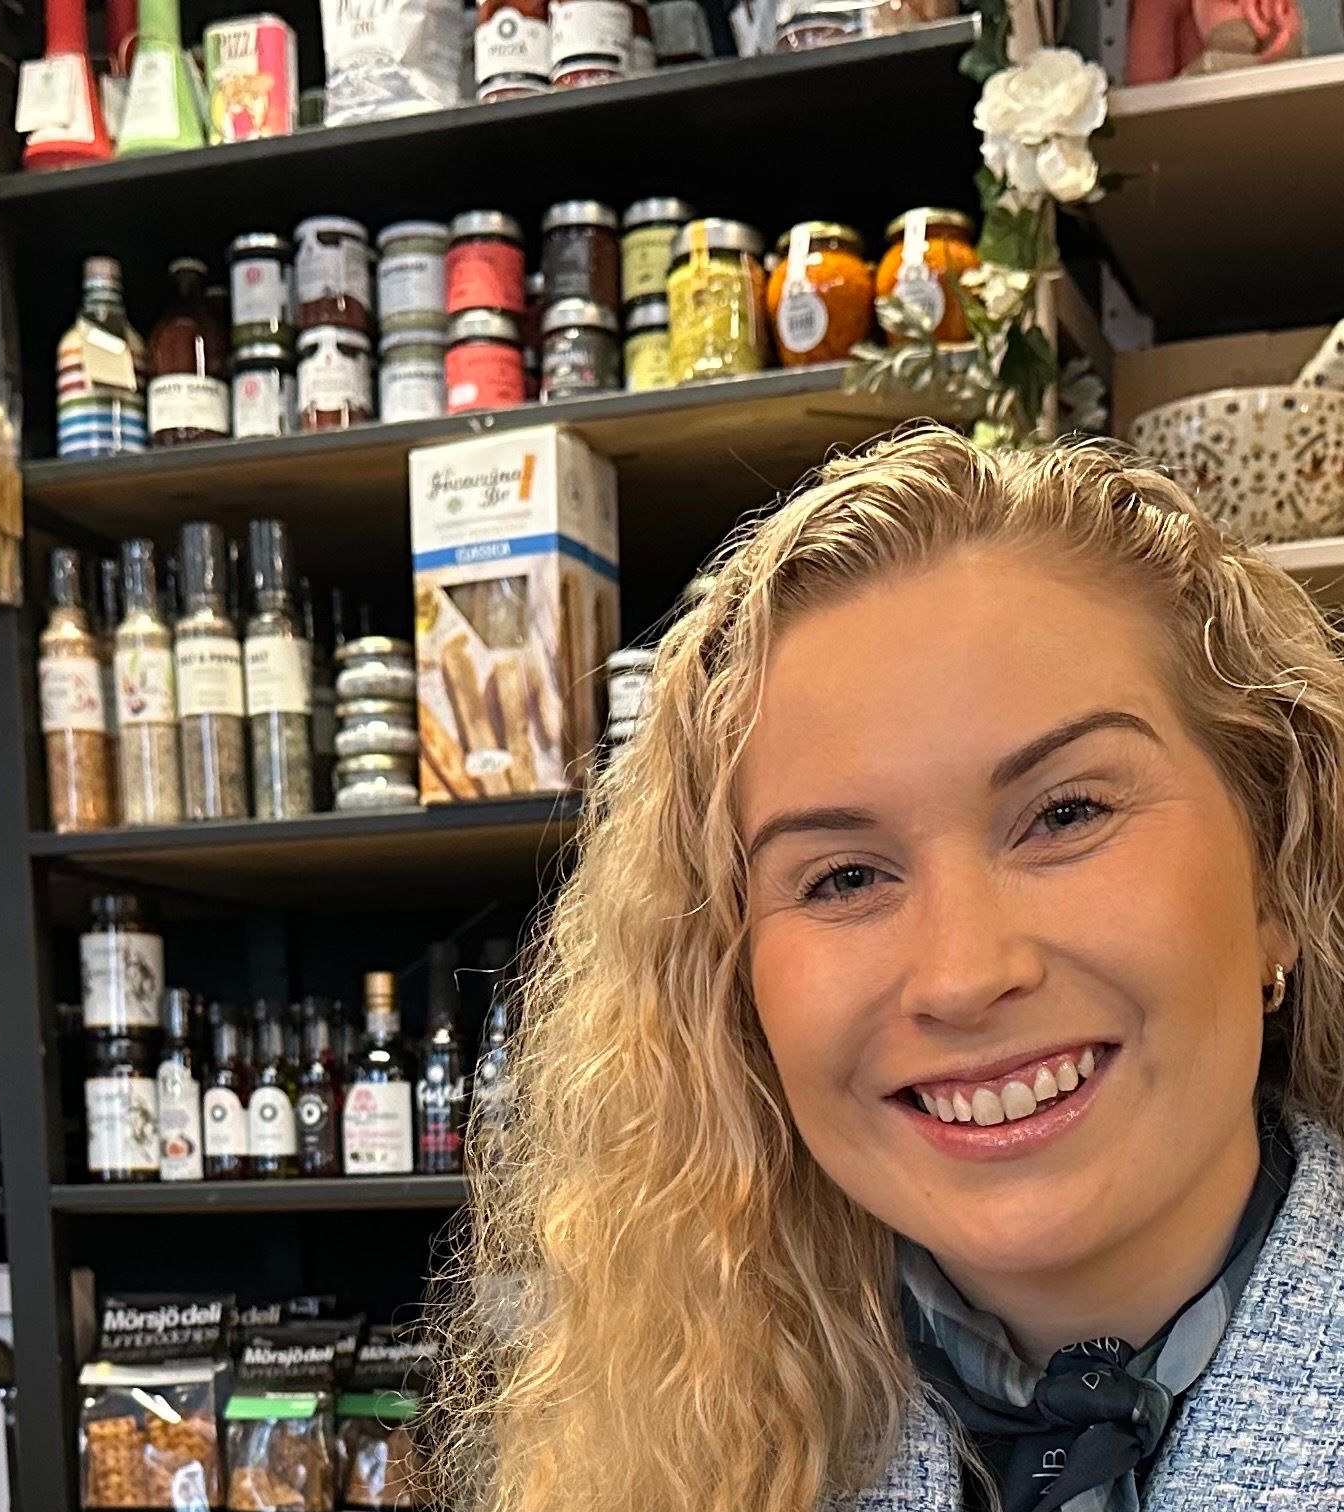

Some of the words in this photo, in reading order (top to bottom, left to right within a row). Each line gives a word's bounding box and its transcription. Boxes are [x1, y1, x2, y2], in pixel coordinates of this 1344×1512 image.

[103, 1305, 181, 1333] Mörsjö
[181, 1302, 223, 1327] deli
[243, 1344, 304, 1368] Mörsjö
